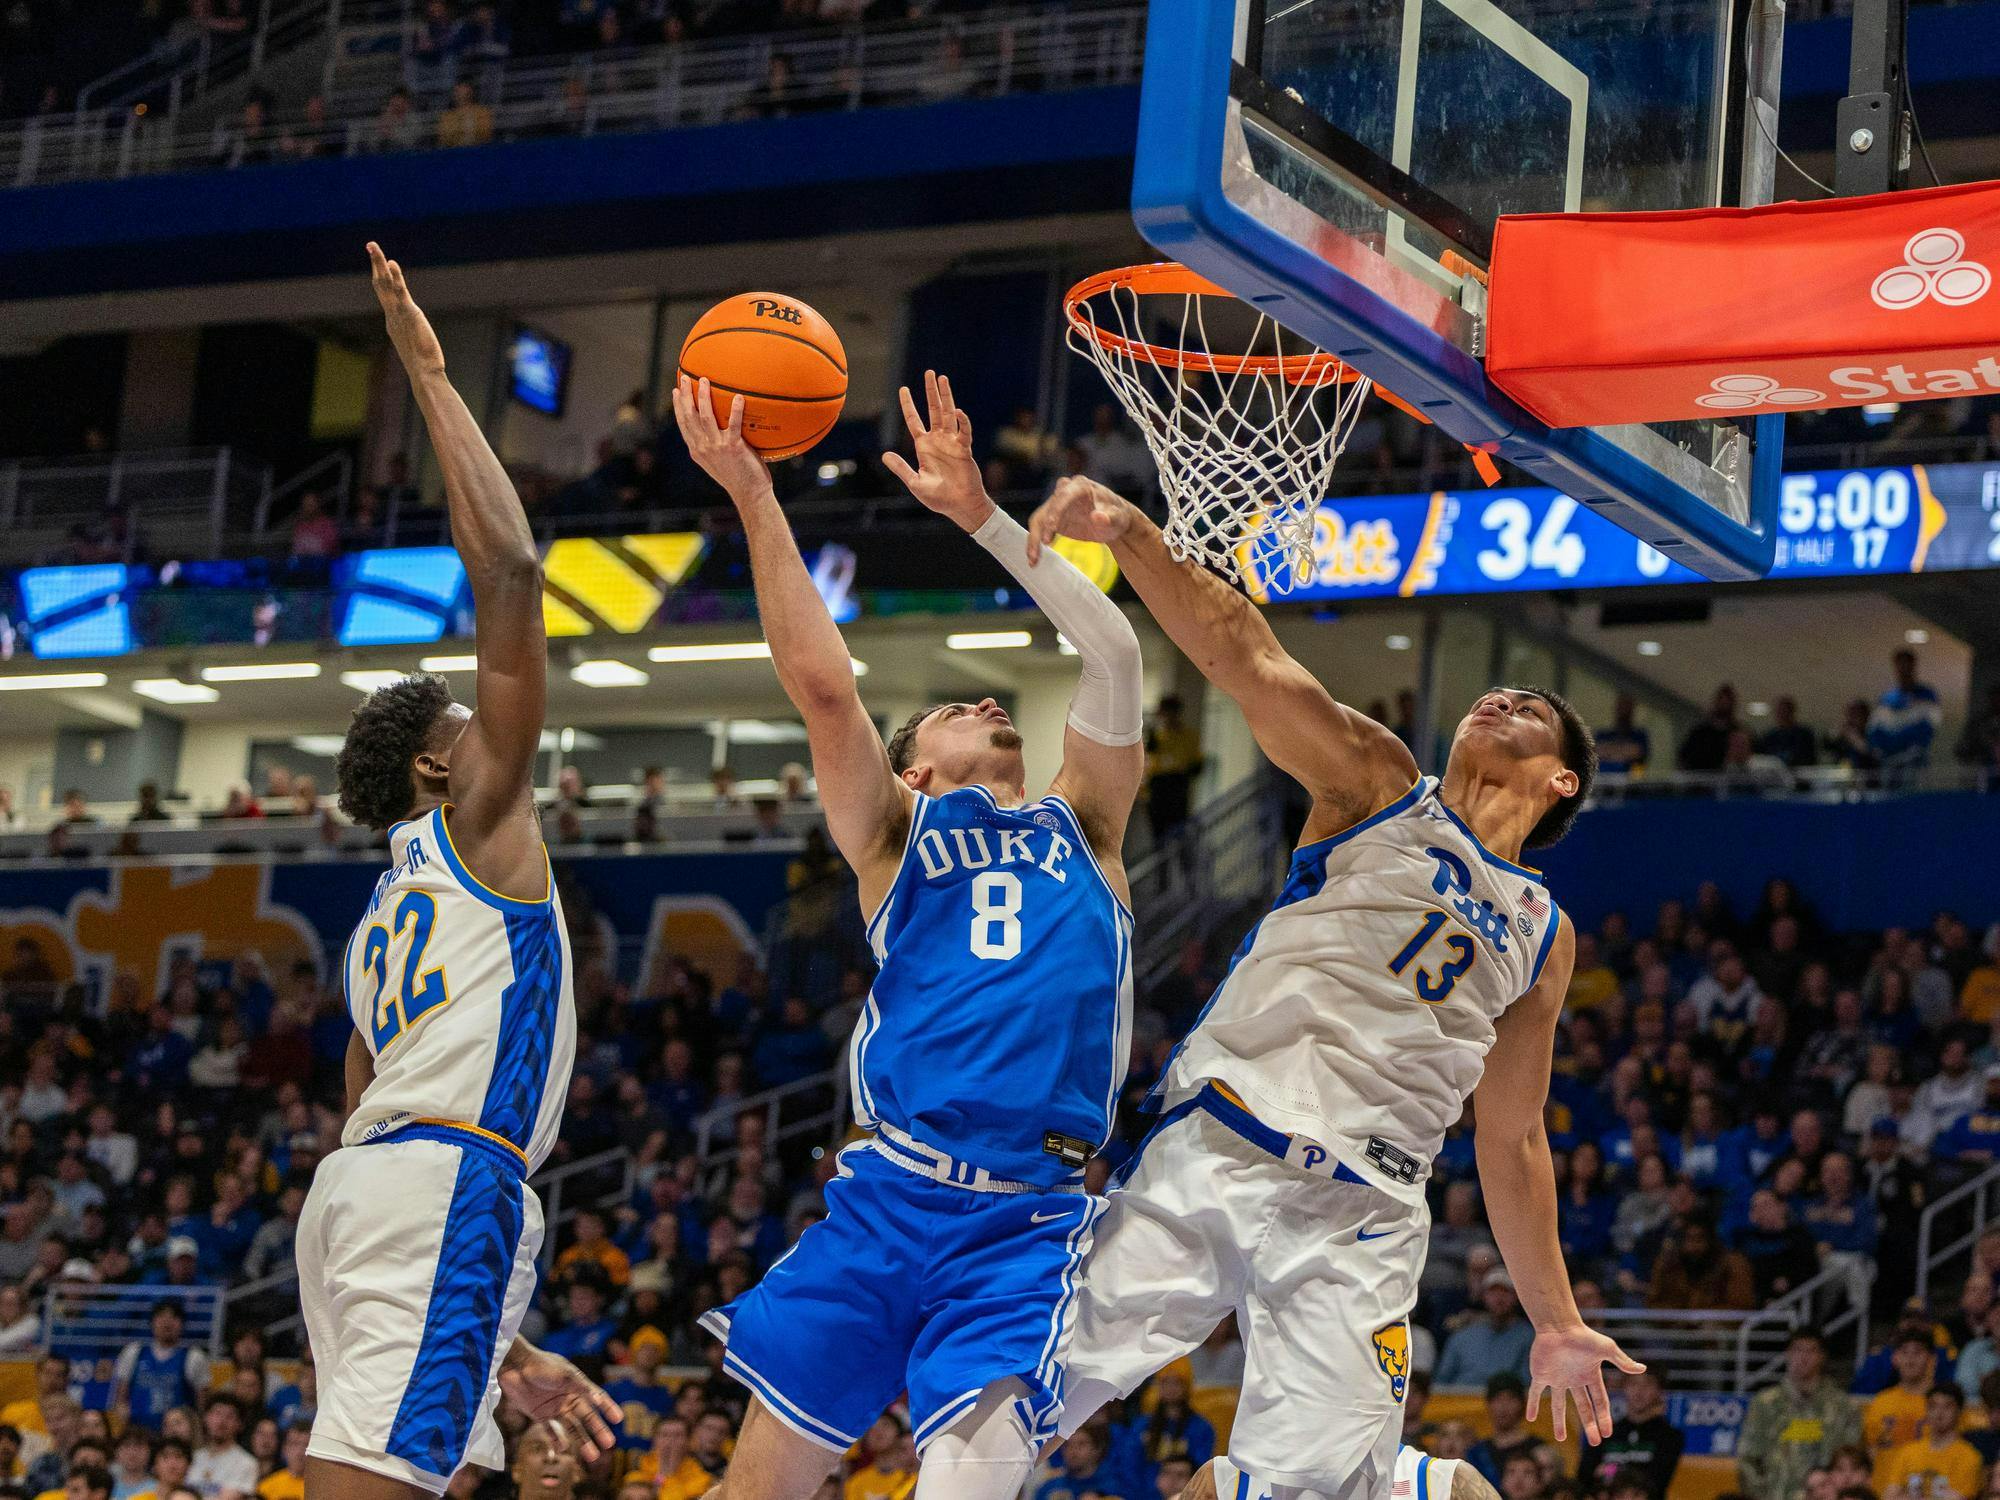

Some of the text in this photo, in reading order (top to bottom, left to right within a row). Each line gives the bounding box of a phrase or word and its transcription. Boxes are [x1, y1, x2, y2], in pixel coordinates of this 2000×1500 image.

[749, 299, 802, 326] Pitt
[1284, 507, 1400, 589] Pitt
[1477, 495, 1586, 581] 34
[1850, 527, 1890, 569] 17
[405, 837, 430, 876] JR.
[916, 828, 1073, 884] DUKE
[970, 871, 1023, 960] 8
[1425, 847, 1510, 953] Pitt
[364, 888, 450, 1056] 22
[1387, 909, 1477, 1004] 13
[1403, 1163, 1413, 1174] 50
